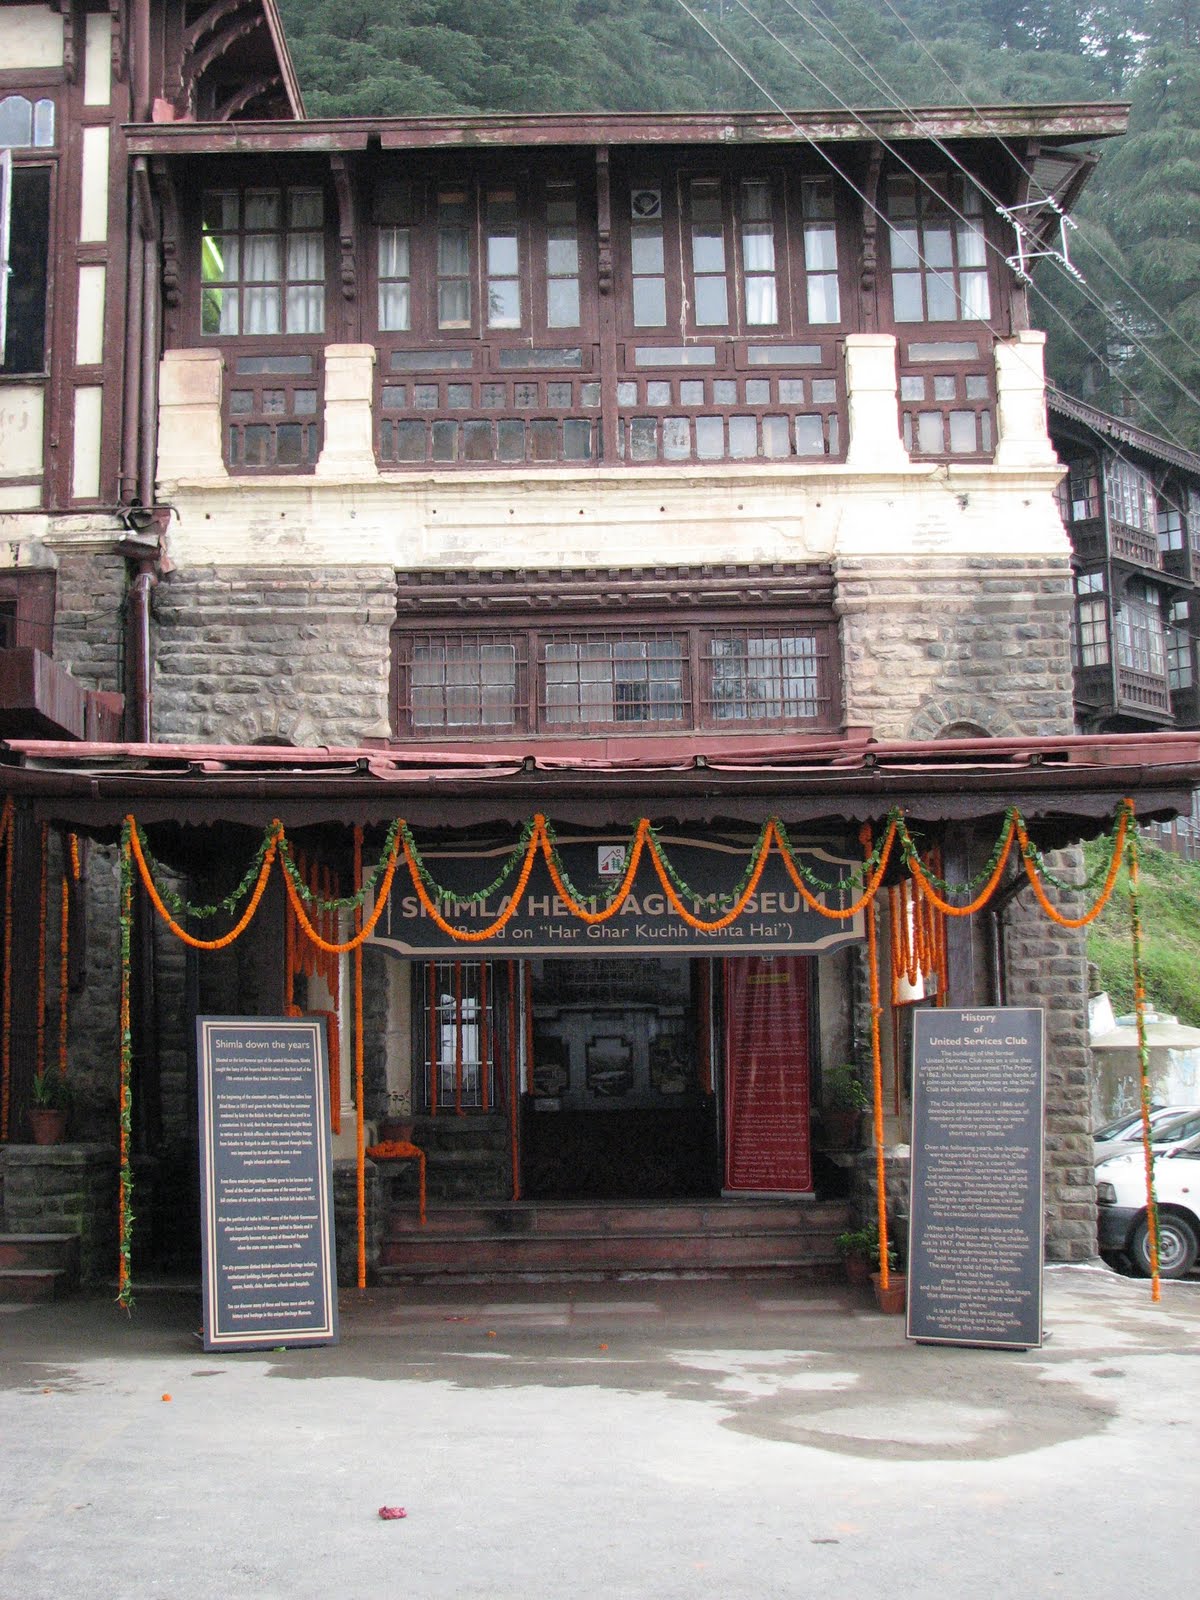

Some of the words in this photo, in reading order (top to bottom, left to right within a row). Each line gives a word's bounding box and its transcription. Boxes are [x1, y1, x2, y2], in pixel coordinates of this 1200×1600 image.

[512, 929, 532, 939] on
[586, 924, 629, 938] Ghar
[635, 923, 688, 938] Kuchh
[961, 1013, 996, 1023] History
[973, 1025, 983, 1033] of
[215, 1039, 242, 1048] Shimla
[245, 1039, 269, 1048] down
[271, 1040, 285, 1048] the
[287, 1041, 309, 1050] years
[929, 1037, 960, 1045] United
[963, 1037, 1002, 1045] Services
[1005, 1036, 1027, 1045] Club
